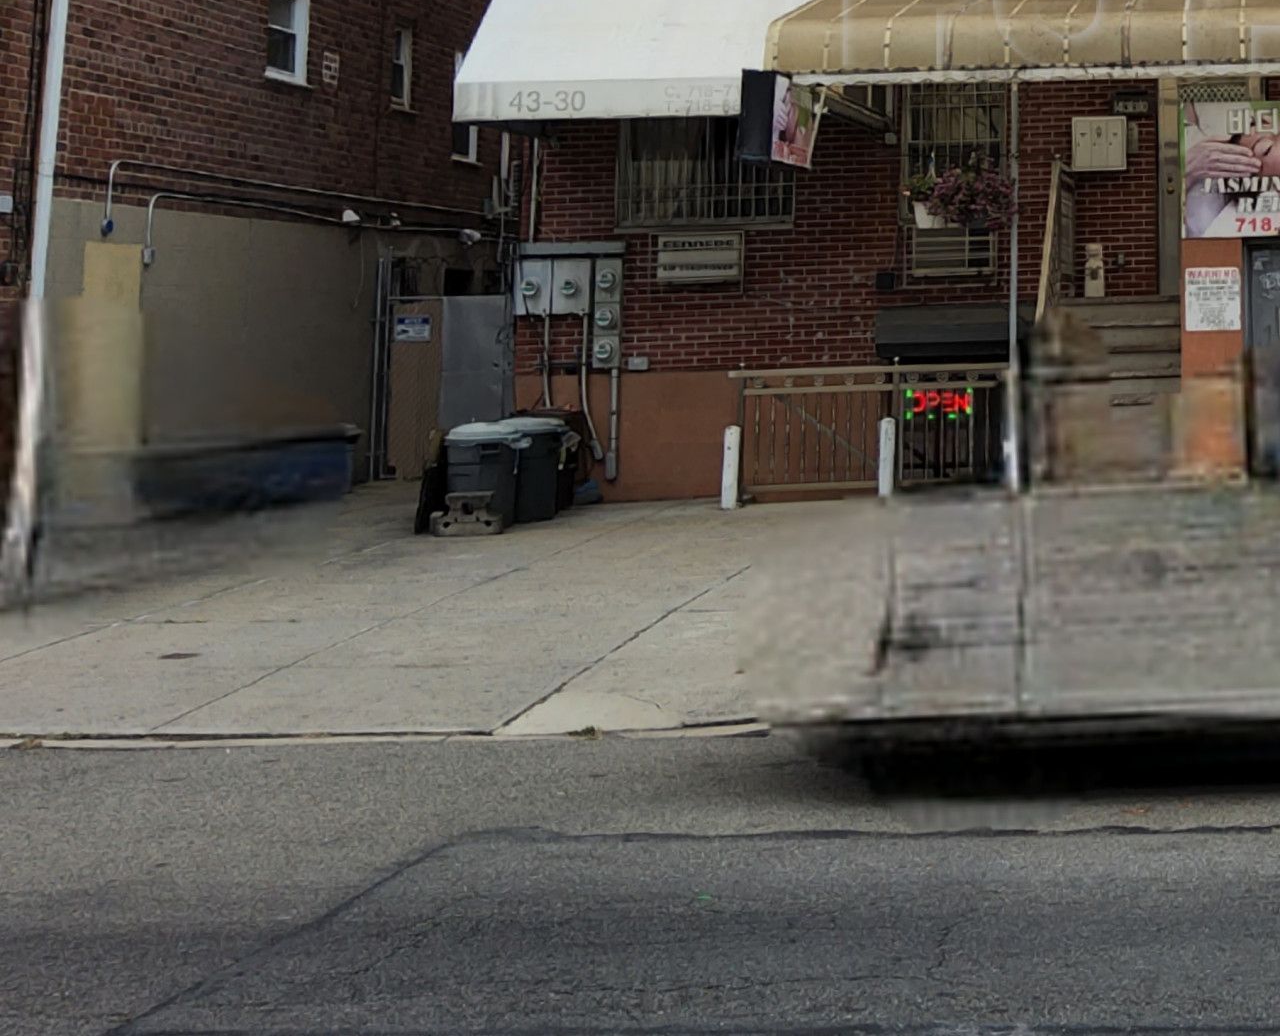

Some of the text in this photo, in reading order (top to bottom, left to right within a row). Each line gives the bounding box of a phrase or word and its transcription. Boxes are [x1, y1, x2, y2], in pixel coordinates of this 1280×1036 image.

[509, 89, 586, 113] 43-30
[1227, 108, 1279, 135] 바디
[911, 390, 973, 413] OPEN
